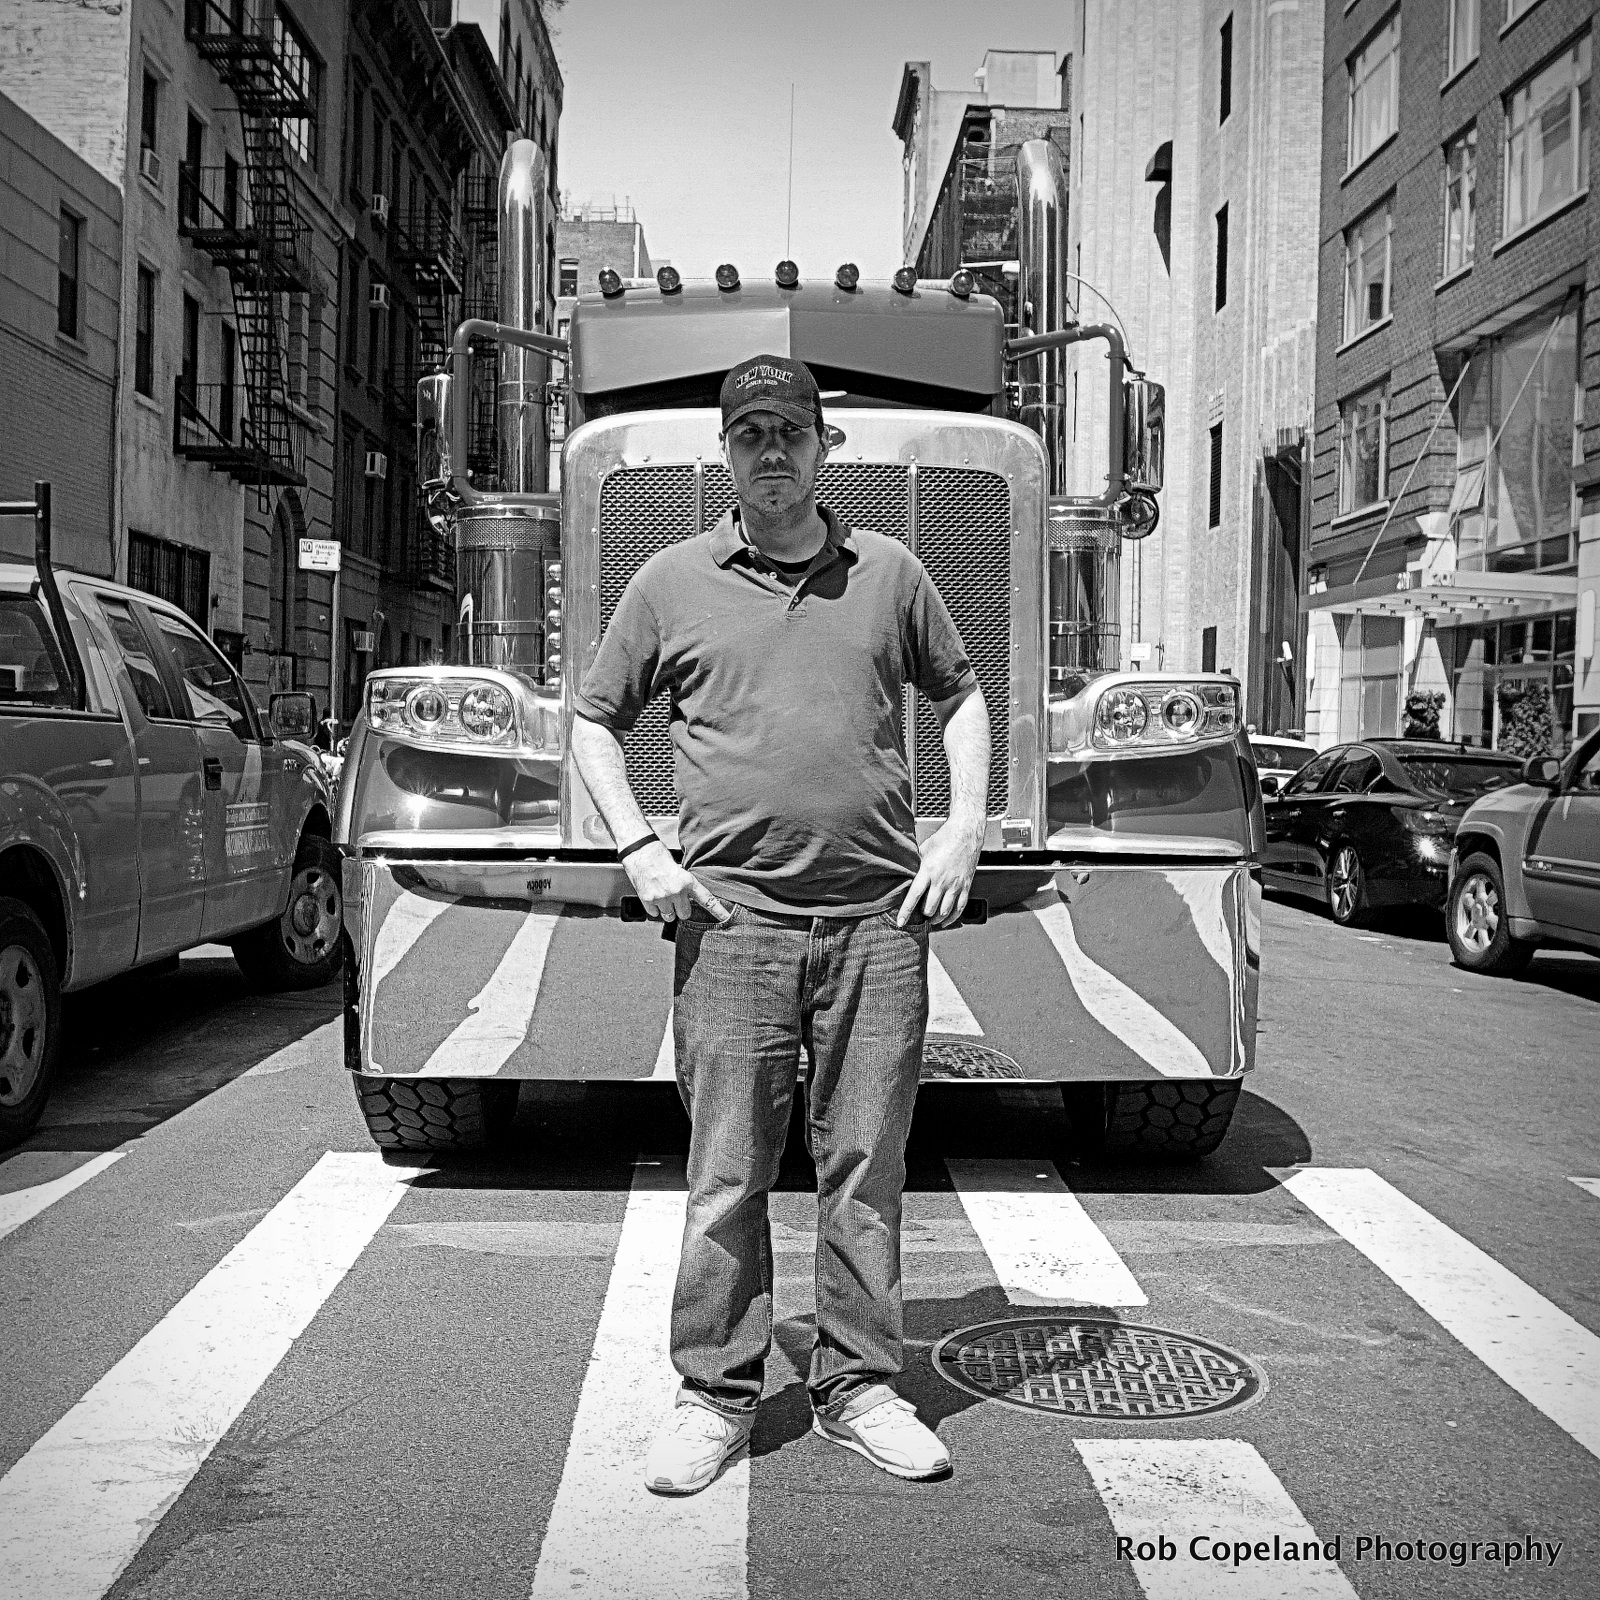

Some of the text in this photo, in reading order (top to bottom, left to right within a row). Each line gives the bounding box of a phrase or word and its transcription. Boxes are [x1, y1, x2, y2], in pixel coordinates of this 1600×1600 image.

[735, 365, 793, 389] NEW YORK
[301, 541, 313, 552] NO
